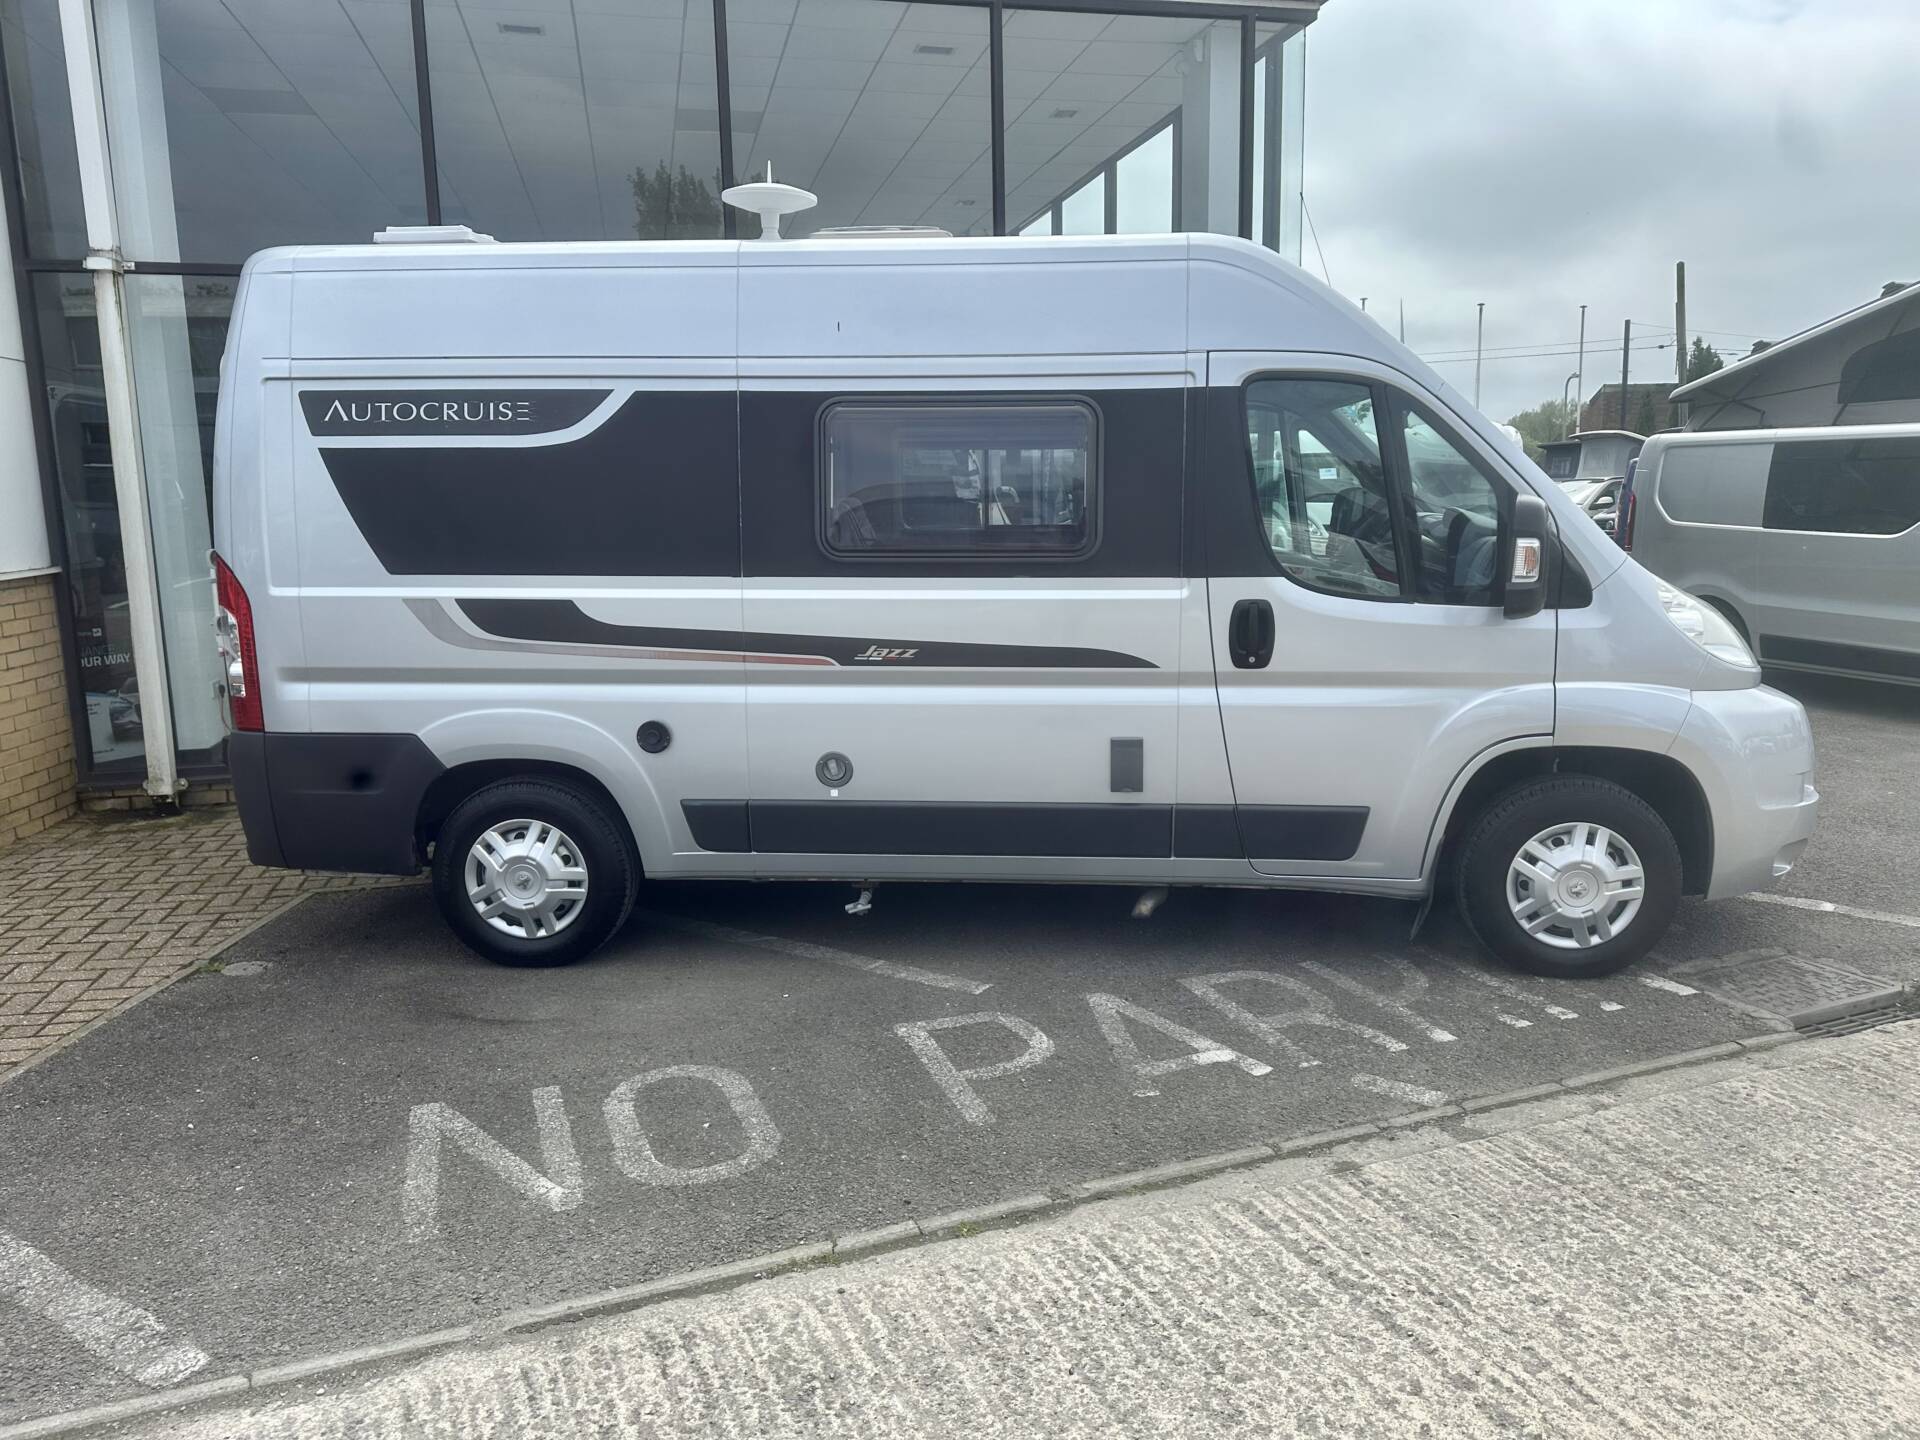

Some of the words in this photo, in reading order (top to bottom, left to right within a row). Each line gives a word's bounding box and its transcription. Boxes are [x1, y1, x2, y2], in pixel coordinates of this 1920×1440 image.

[323, 399, 530, 423] AUTOCRUISE
[104, 653, 130, 665] WAY
[856, 645, 919, 659] Jazz
[403, 1063, 783, 1243] NO
